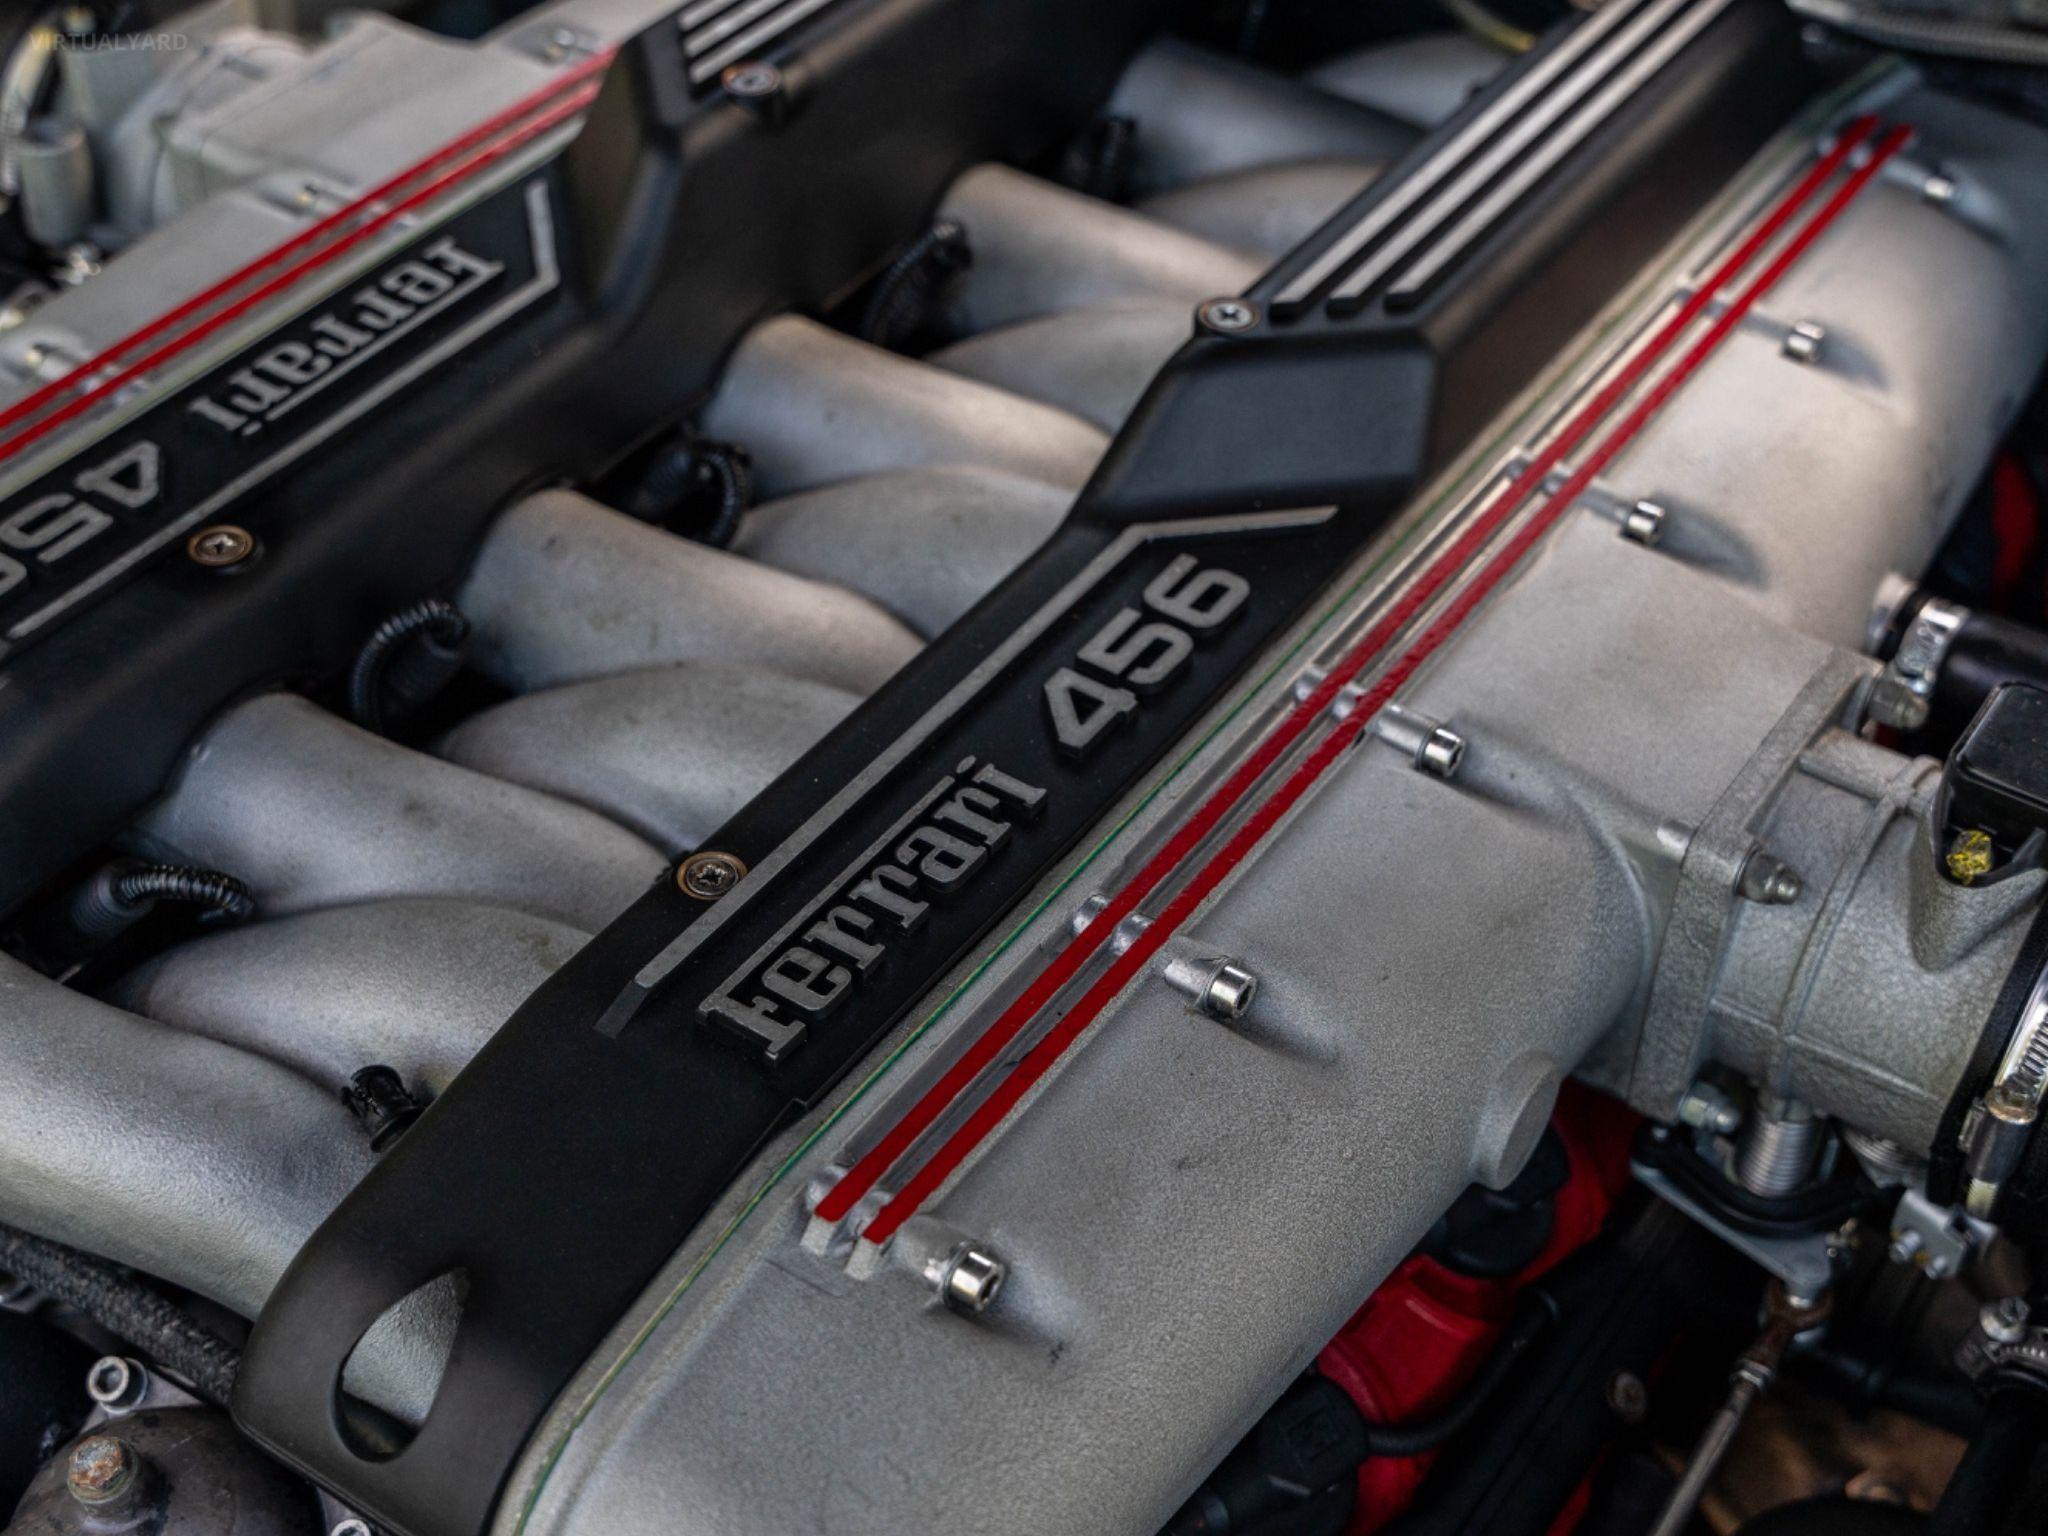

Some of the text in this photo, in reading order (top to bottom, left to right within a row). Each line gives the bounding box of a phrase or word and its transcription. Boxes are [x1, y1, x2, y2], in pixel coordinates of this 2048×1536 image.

[0, 235, 505, 596] Ferrari 45
[699, 552, 1251, 1060] Ferrari 456
